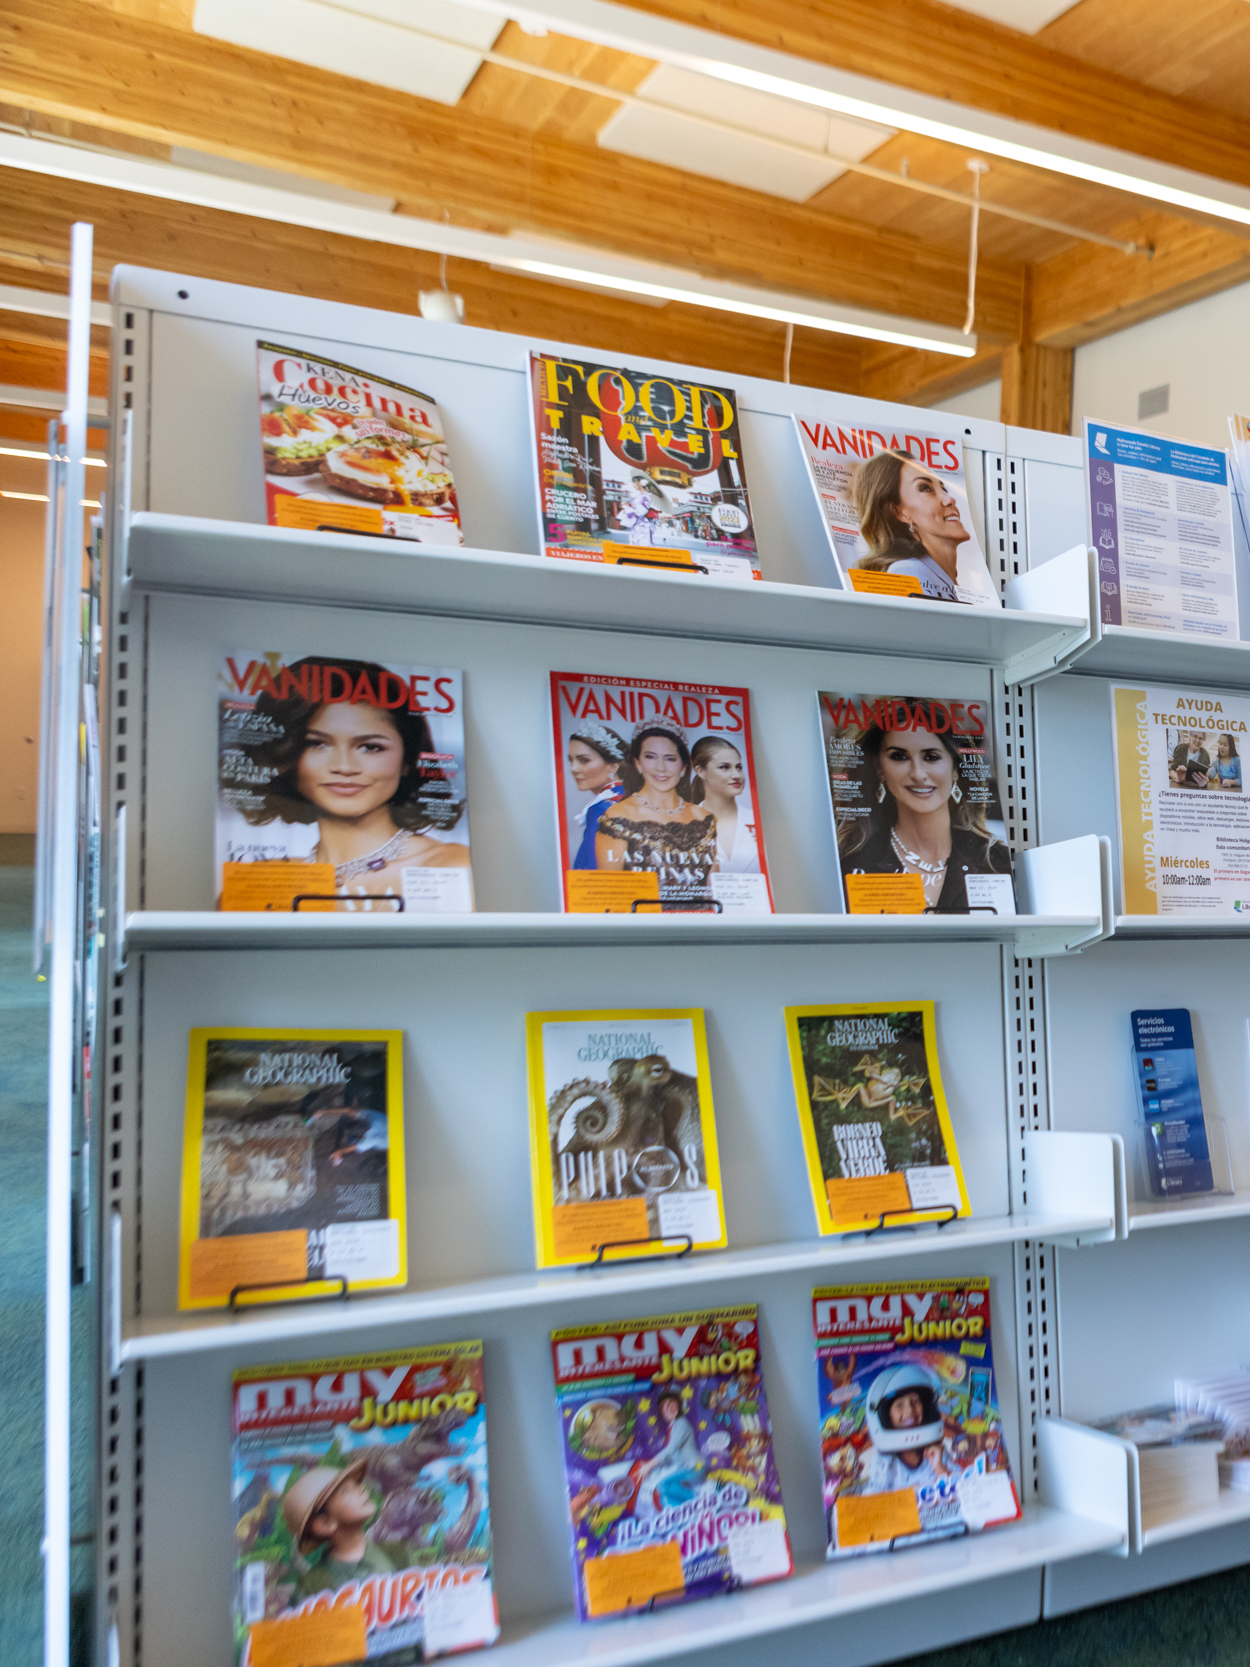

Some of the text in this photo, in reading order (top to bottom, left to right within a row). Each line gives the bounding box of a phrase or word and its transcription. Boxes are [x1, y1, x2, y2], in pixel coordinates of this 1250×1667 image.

[306, 363, 361, 387] KENA
[273, 359, 433, 428] Cocina
[278, 385, 362, 415] Huevos
[537, 358, 734, 432] FOOD
[623, 414, 650, 425] and
[371, 425, 407, 439] formas
[541, 432, 569, 444] Sazón
[545, 408, 738, 459] TRAVEL
[541, 441, 578, 453] maestra
[800, 420, 960, 471] VANIDADES
[811, 456, 843, 470] Realeza
[545, 488, 587, 500] CRUCERO
[545, 495, 597, 508] POR EL MAR
[546, 502, 593, 514] ADRIÁTICO
[570, 511, 599, 519] POSTALES
[558, 514, 584, 522] CUENTO
[549, 523, 566, 542] 5
[551, 550, 588, 560] VIAJEROS
[226, 657, 455, 714] VANIDADES
[583, 675, 720, 694] EDICIÓN ESPECIAL REALEZA
[560, 685, 744, 733] VANIDADES
[1176, 697, 1223, 713] AYUDA
[822, 696, 985, 735] VANIDADES
[1152, 712, 1248, 733] TECNOLÓGICA
[1135, 700, 1157, 893] AYUDA TECNOLÓGICA
[607, 849, 725, 866] LAS NUEVAS
[1160, 856, 1210, 869] Miércoles
[1162, 874, 1211, 886] 10:00am-12:00am
[834, 1018, 892, 1032] NATIONAL
[1137, 1018, 1164, 1026] Servicios
[1139, 1026, 1175, 1034] electrónicos
[587, 1031, 655, 1047] NATIONAL
[827, 1029, 900, 1047] GEOGRAPHIC
[259, 1053, 344, 1069] NATIONAL
[577, 1044, 663, 1063] GEOGRAPHIC
[244, 1066, 352, 1085] GEOGRAPHIC
[832, 1121, 883, 1141] BORNEO
[696, 1308, 756, 1321] SUBMARINO
[895, 1316, 984, 1345] JUNIOR
[651, 1348, 757, 1384] JUNIOR
[349, 1390, 479, 1432] JUNIOR
